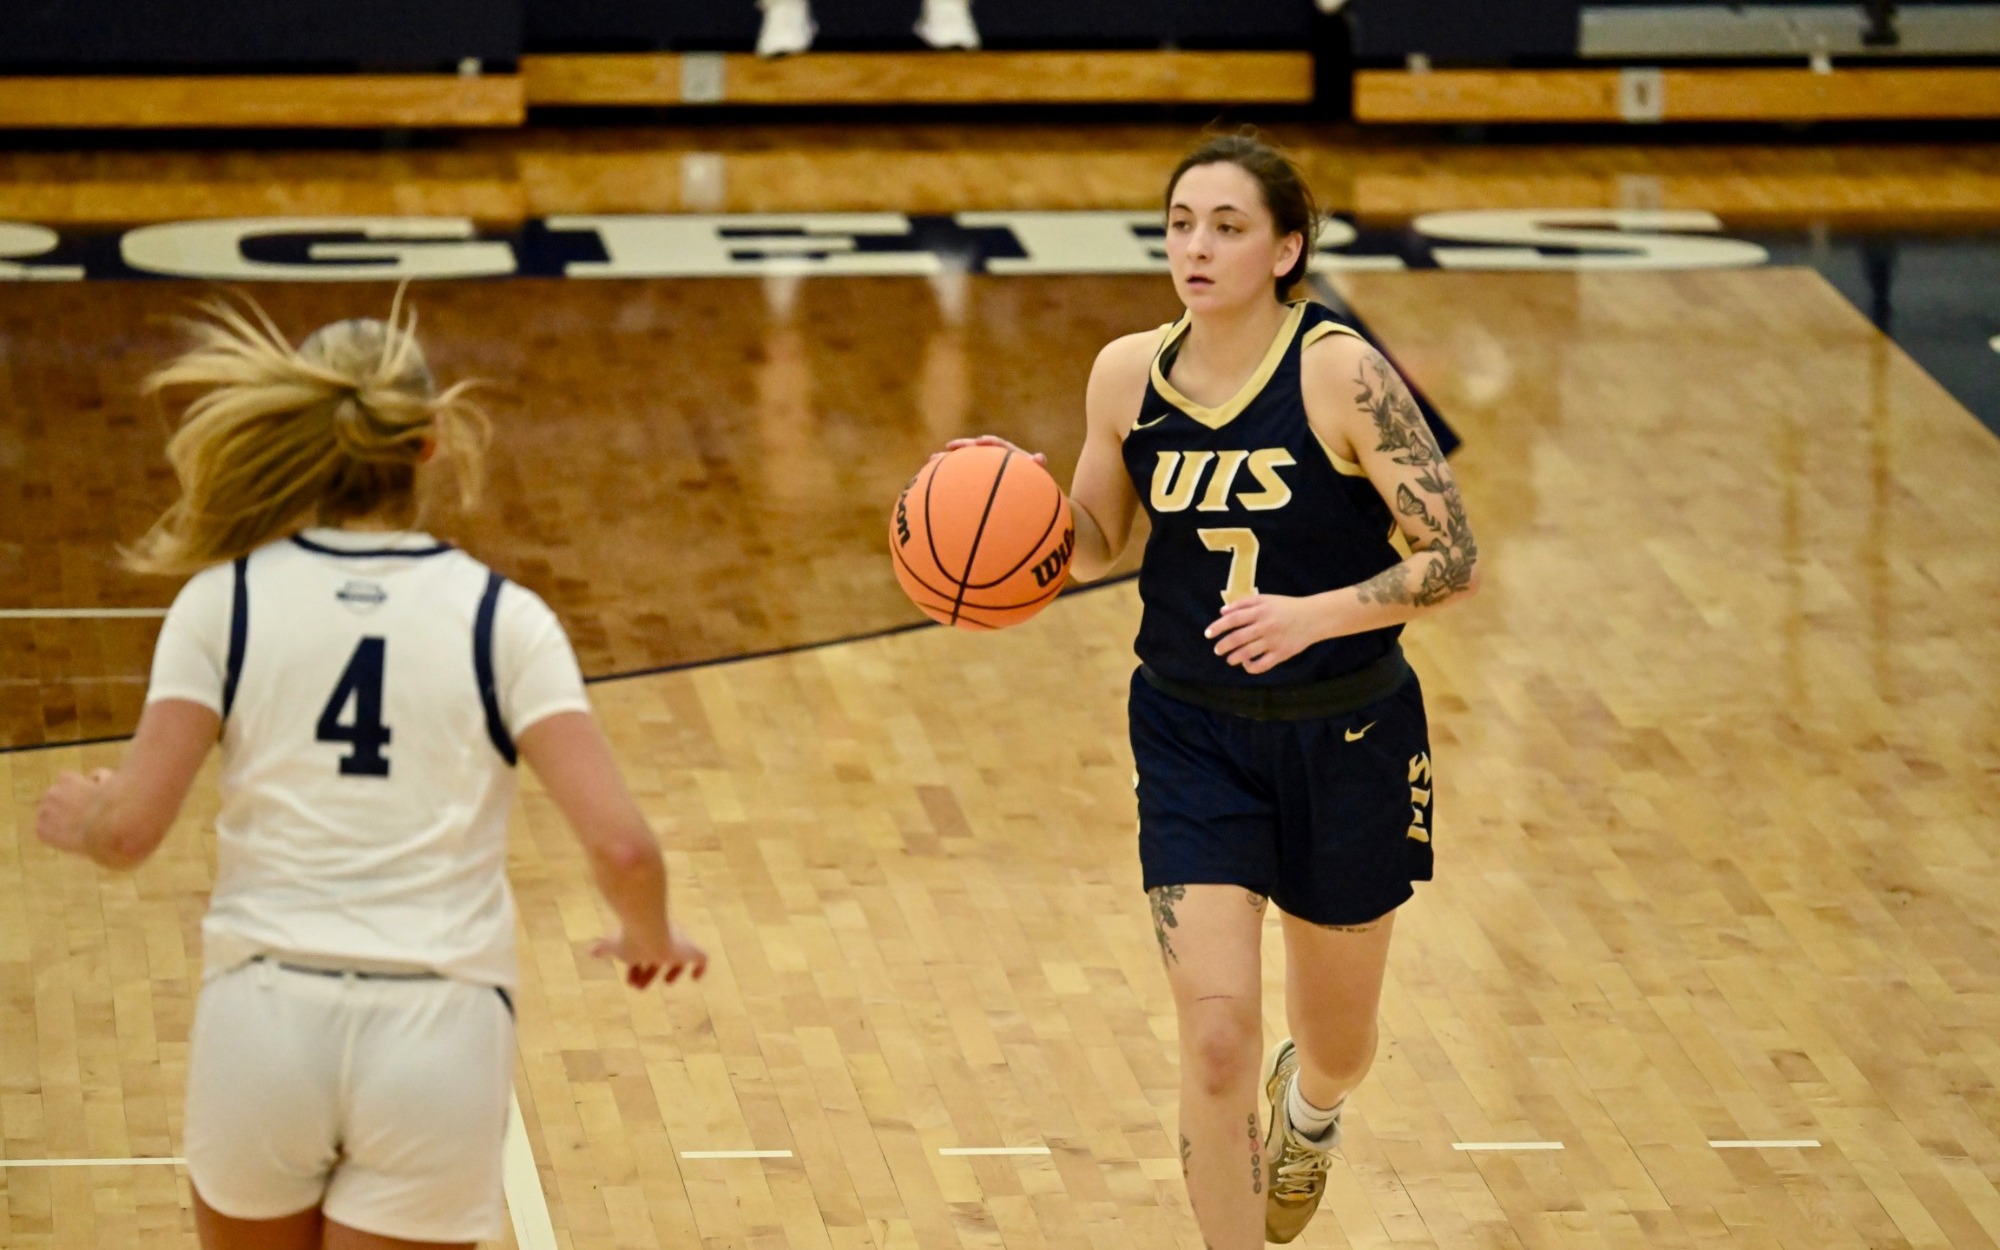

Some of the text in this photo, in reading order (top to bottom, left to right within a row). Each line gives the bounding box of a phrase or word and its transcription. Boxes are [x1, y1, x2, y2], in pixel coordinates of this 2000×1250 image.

[0, 209, 1769, 282] GERS
[1150, 447, 1297, 512] UIS
[1196, 527, 1260, 606] 7
[315, 634, 392, 778] 4
